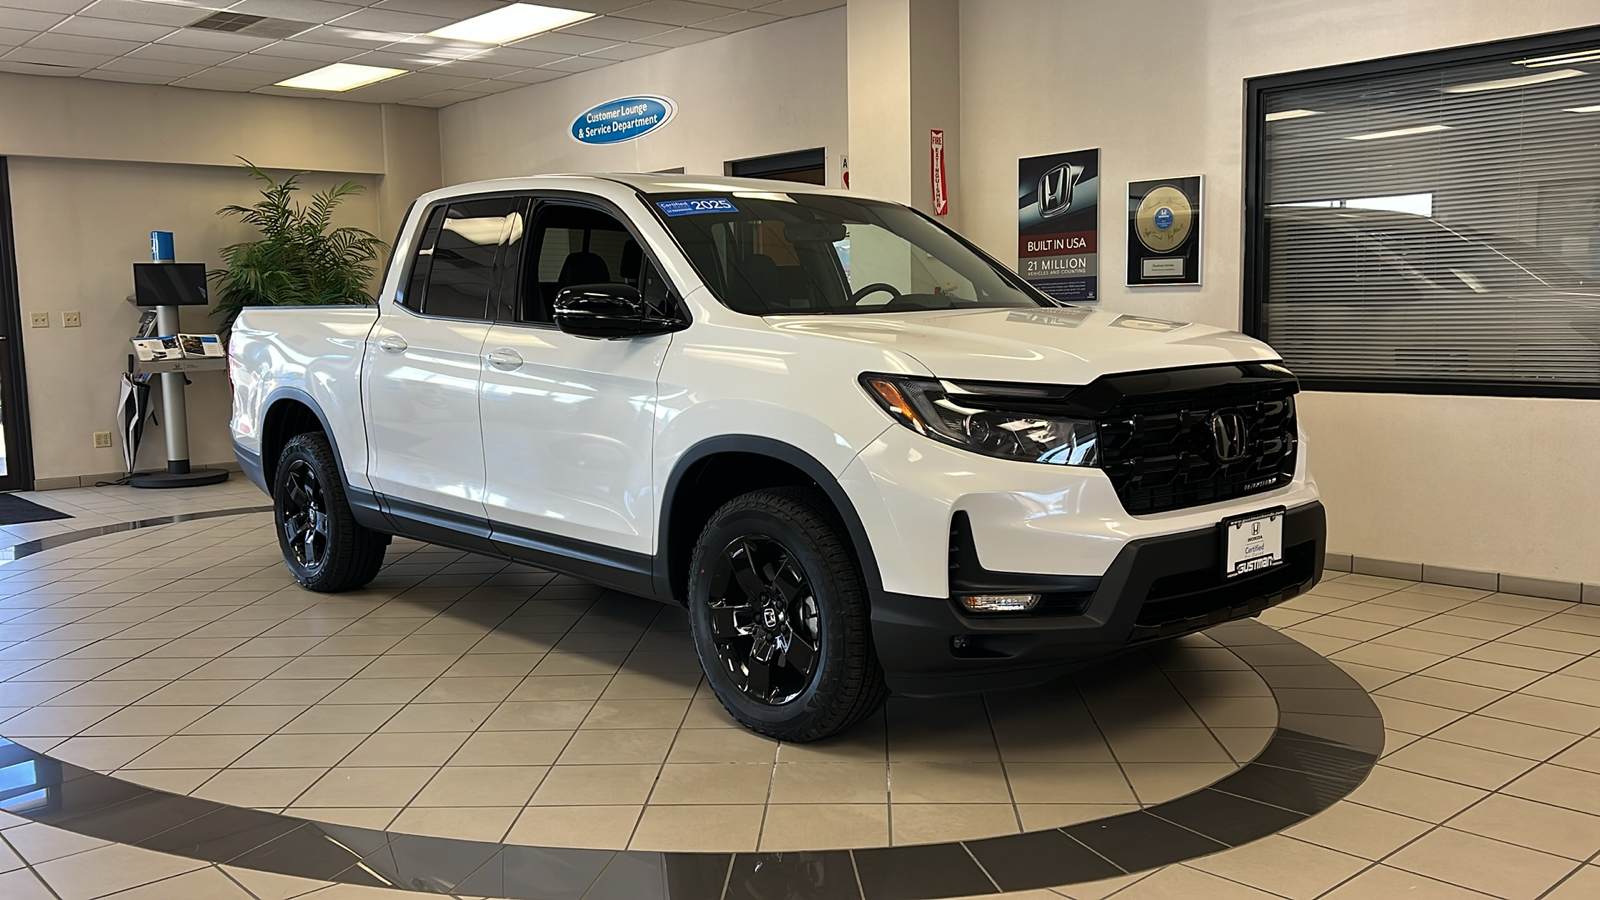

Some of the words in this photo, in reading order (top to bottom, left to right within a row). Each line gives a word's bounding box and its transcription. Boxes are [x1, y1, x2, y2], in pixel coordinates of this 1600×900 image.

[586, 110, 620, 123] Customer
[621, 103, 648, 117] Lounge
[578, 128, 585, 139] &
[585, 122, 611, 137] Service
[612, 114, 658, 133] Department
[932, 136, 942, 145] FIRE
[934, 147, 942, 208] EXTINGUISHER
[690, 200, 732, 210] 2025
[1027, 239, 1053, 252] BUILT
[1053, 238, 1064, 250] IN
[1066, 237, 1087, 249] USA
[1027, 261, 1038, 271] 21
[1041, 257, 1087, 271] MILLION
[1245, 543, 1265, 555] Certified
